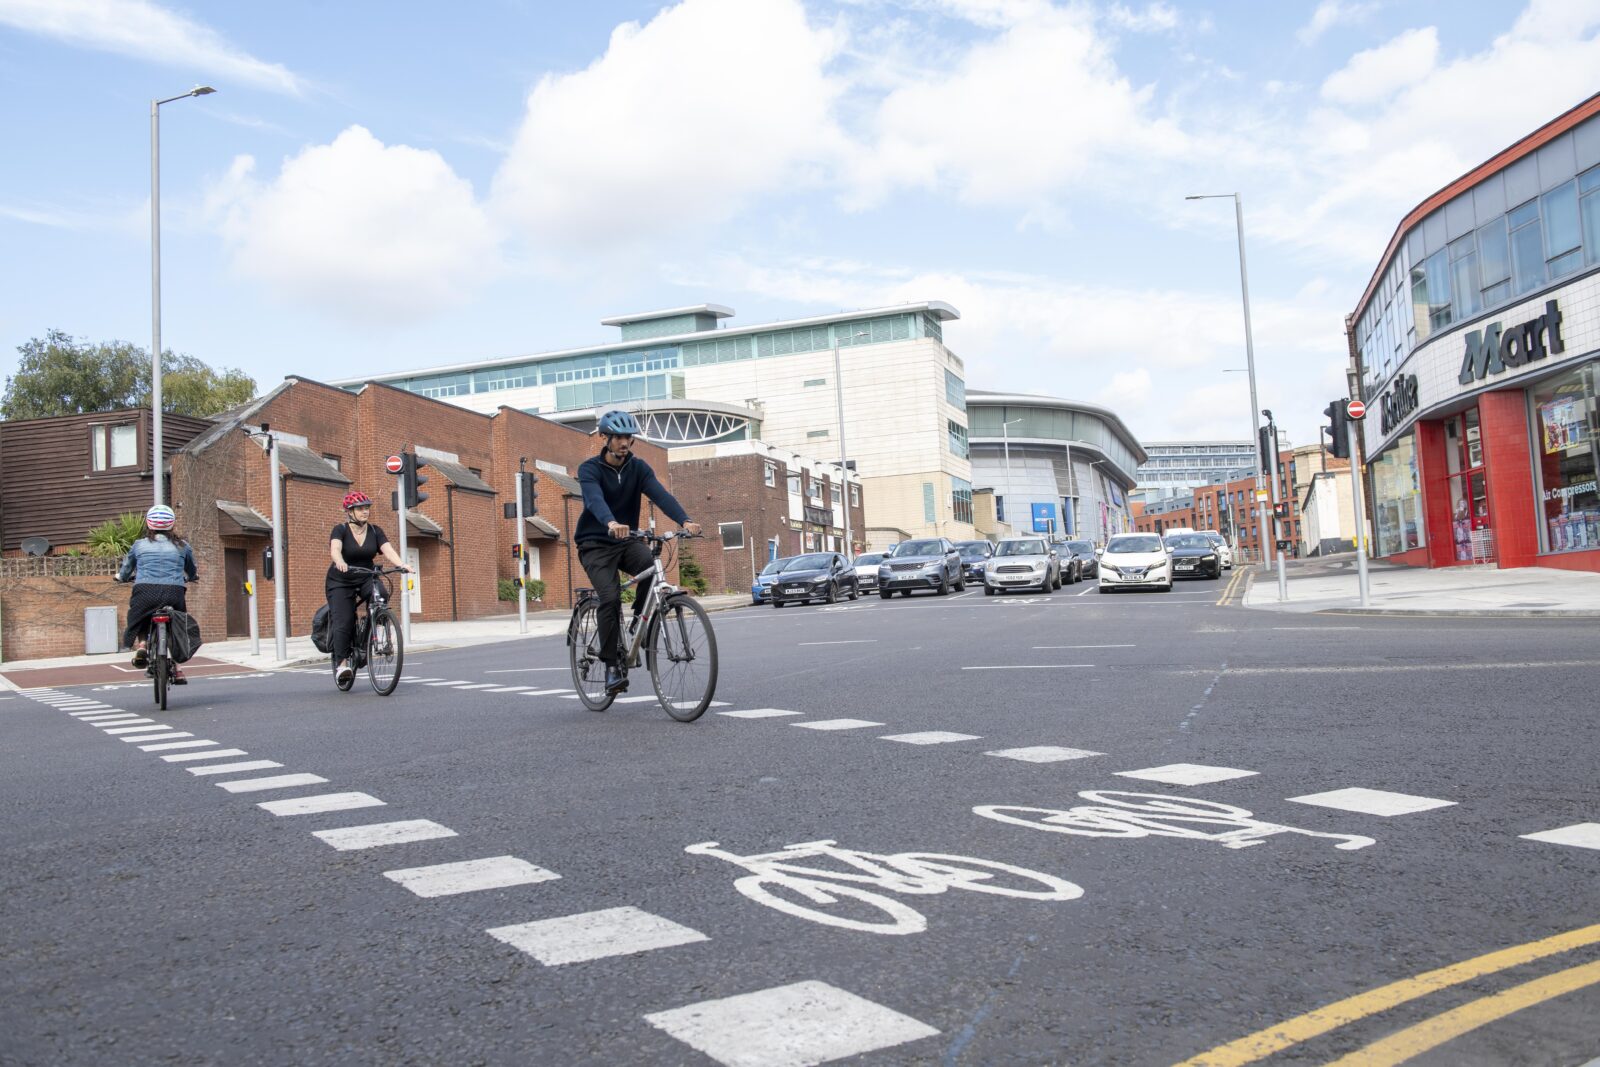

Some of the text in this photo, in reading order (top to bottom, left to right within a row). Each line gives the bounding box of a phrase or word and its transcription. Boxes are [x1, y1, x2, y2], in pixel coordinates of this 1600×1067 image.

[1458, 299, 1565, 385] Mart
[1543, 481, 1597, 501] Air Compressors
